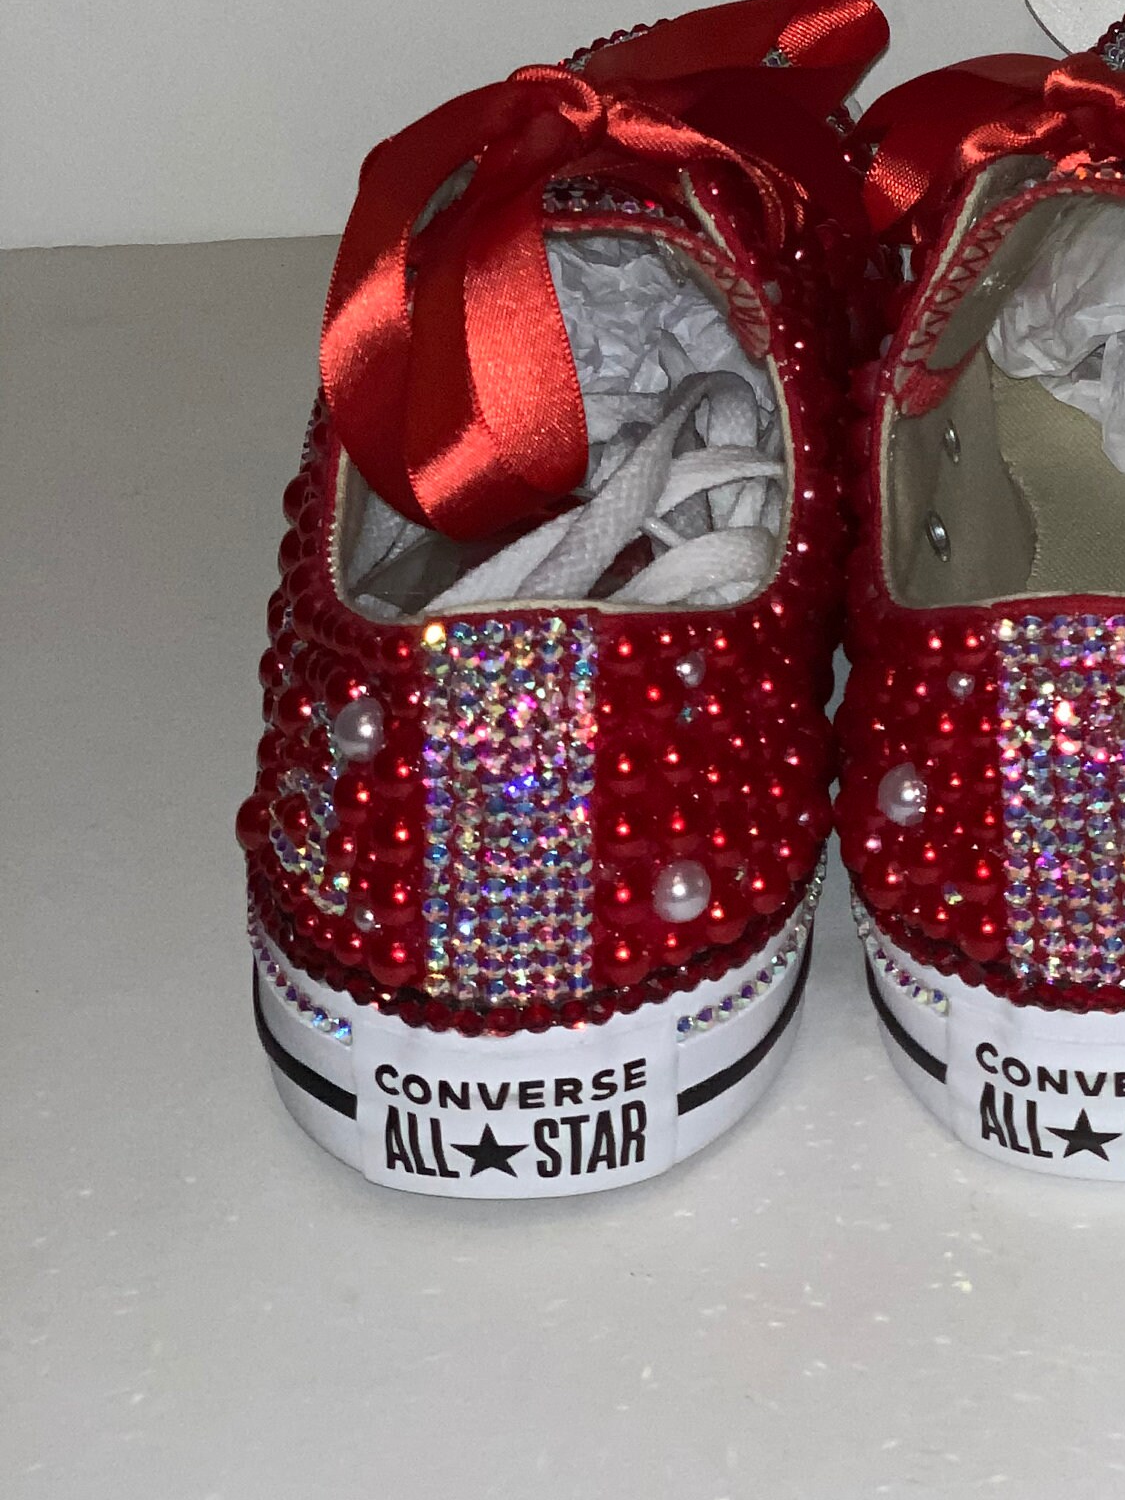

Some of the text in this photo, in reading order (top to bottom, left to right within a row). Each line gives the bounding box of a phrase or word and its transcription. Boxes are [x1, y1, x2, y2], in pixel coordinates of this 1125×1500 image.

[375, 1057, 647, 1110] CONVERSE
[979, 1081, 1054, 1159] ALL
[385, 1099, 647, 1178] ALL STAR
